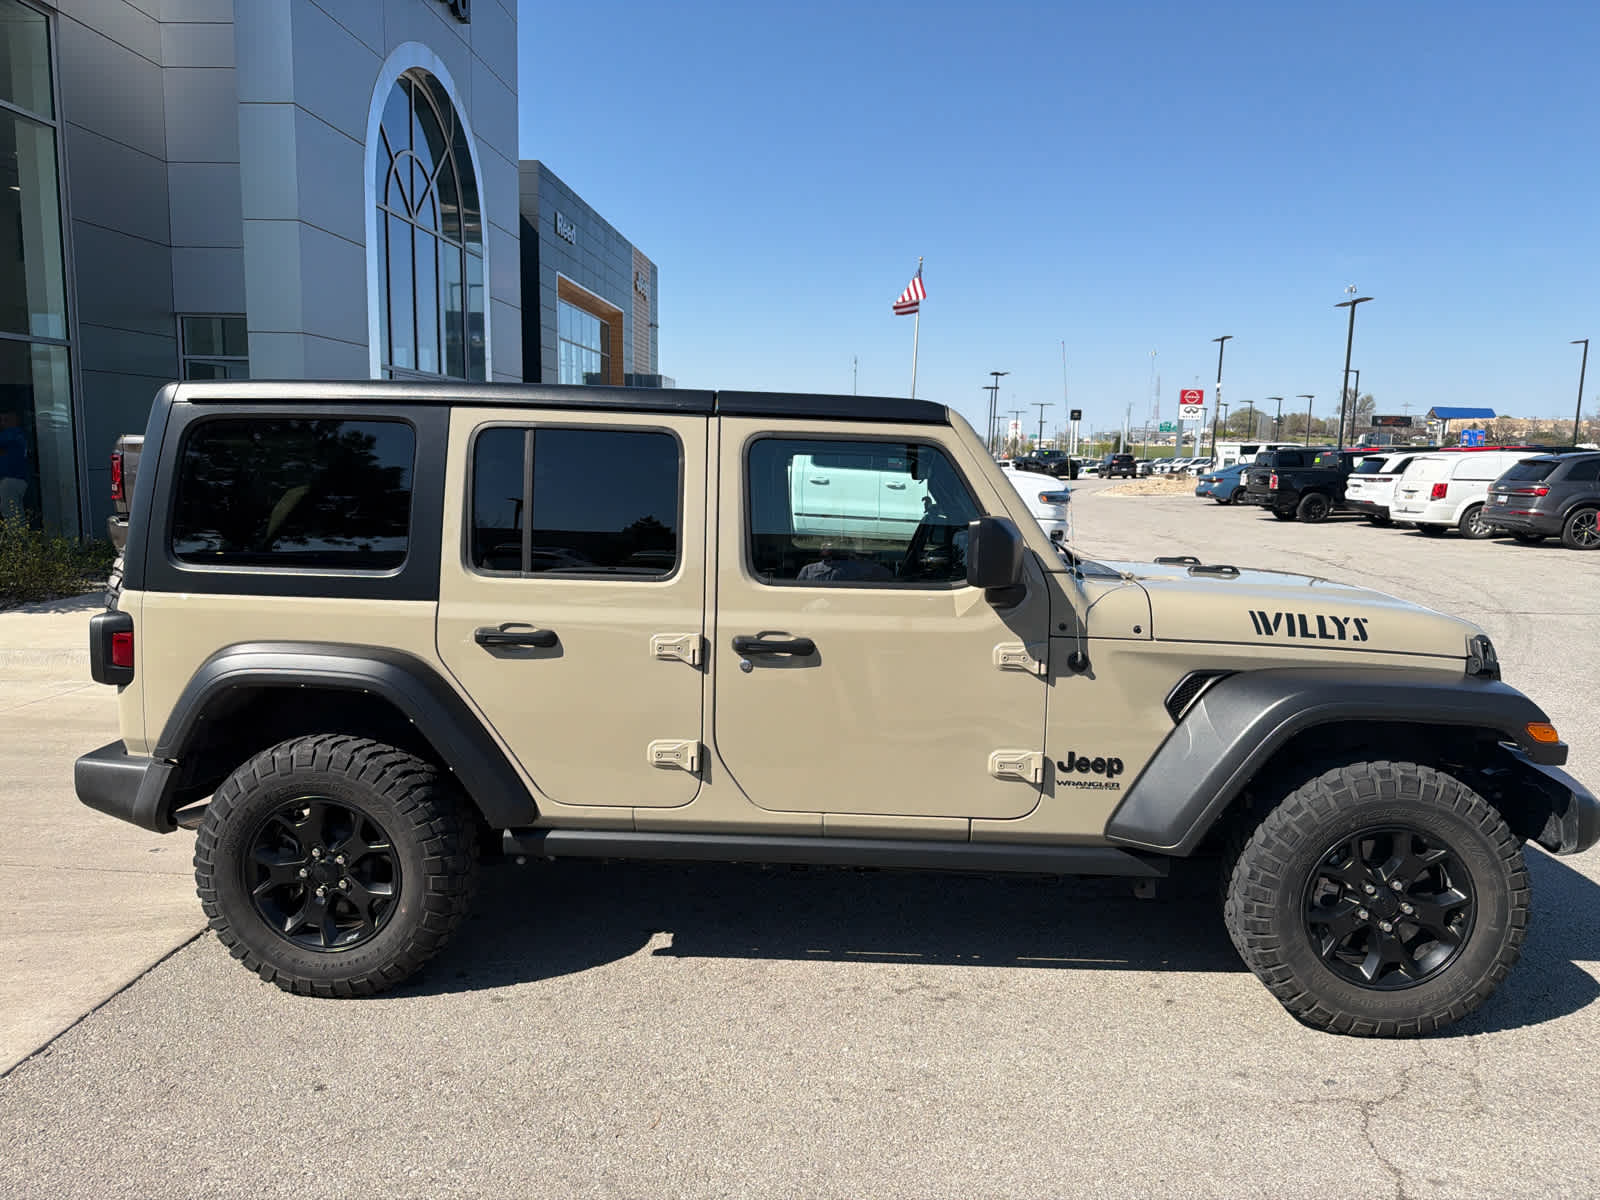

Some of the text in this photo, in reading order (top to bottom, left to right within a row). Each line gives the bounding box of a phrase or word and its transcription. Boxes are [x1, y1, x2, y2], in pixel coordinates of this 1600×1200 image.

[555, 211, 577, 245] Reed
[1248, 610, 1369, 642] WILLYS
[1056, 751, 1124, 779] Jeep
[1056, 780, 1121, 788] WRANGLER
